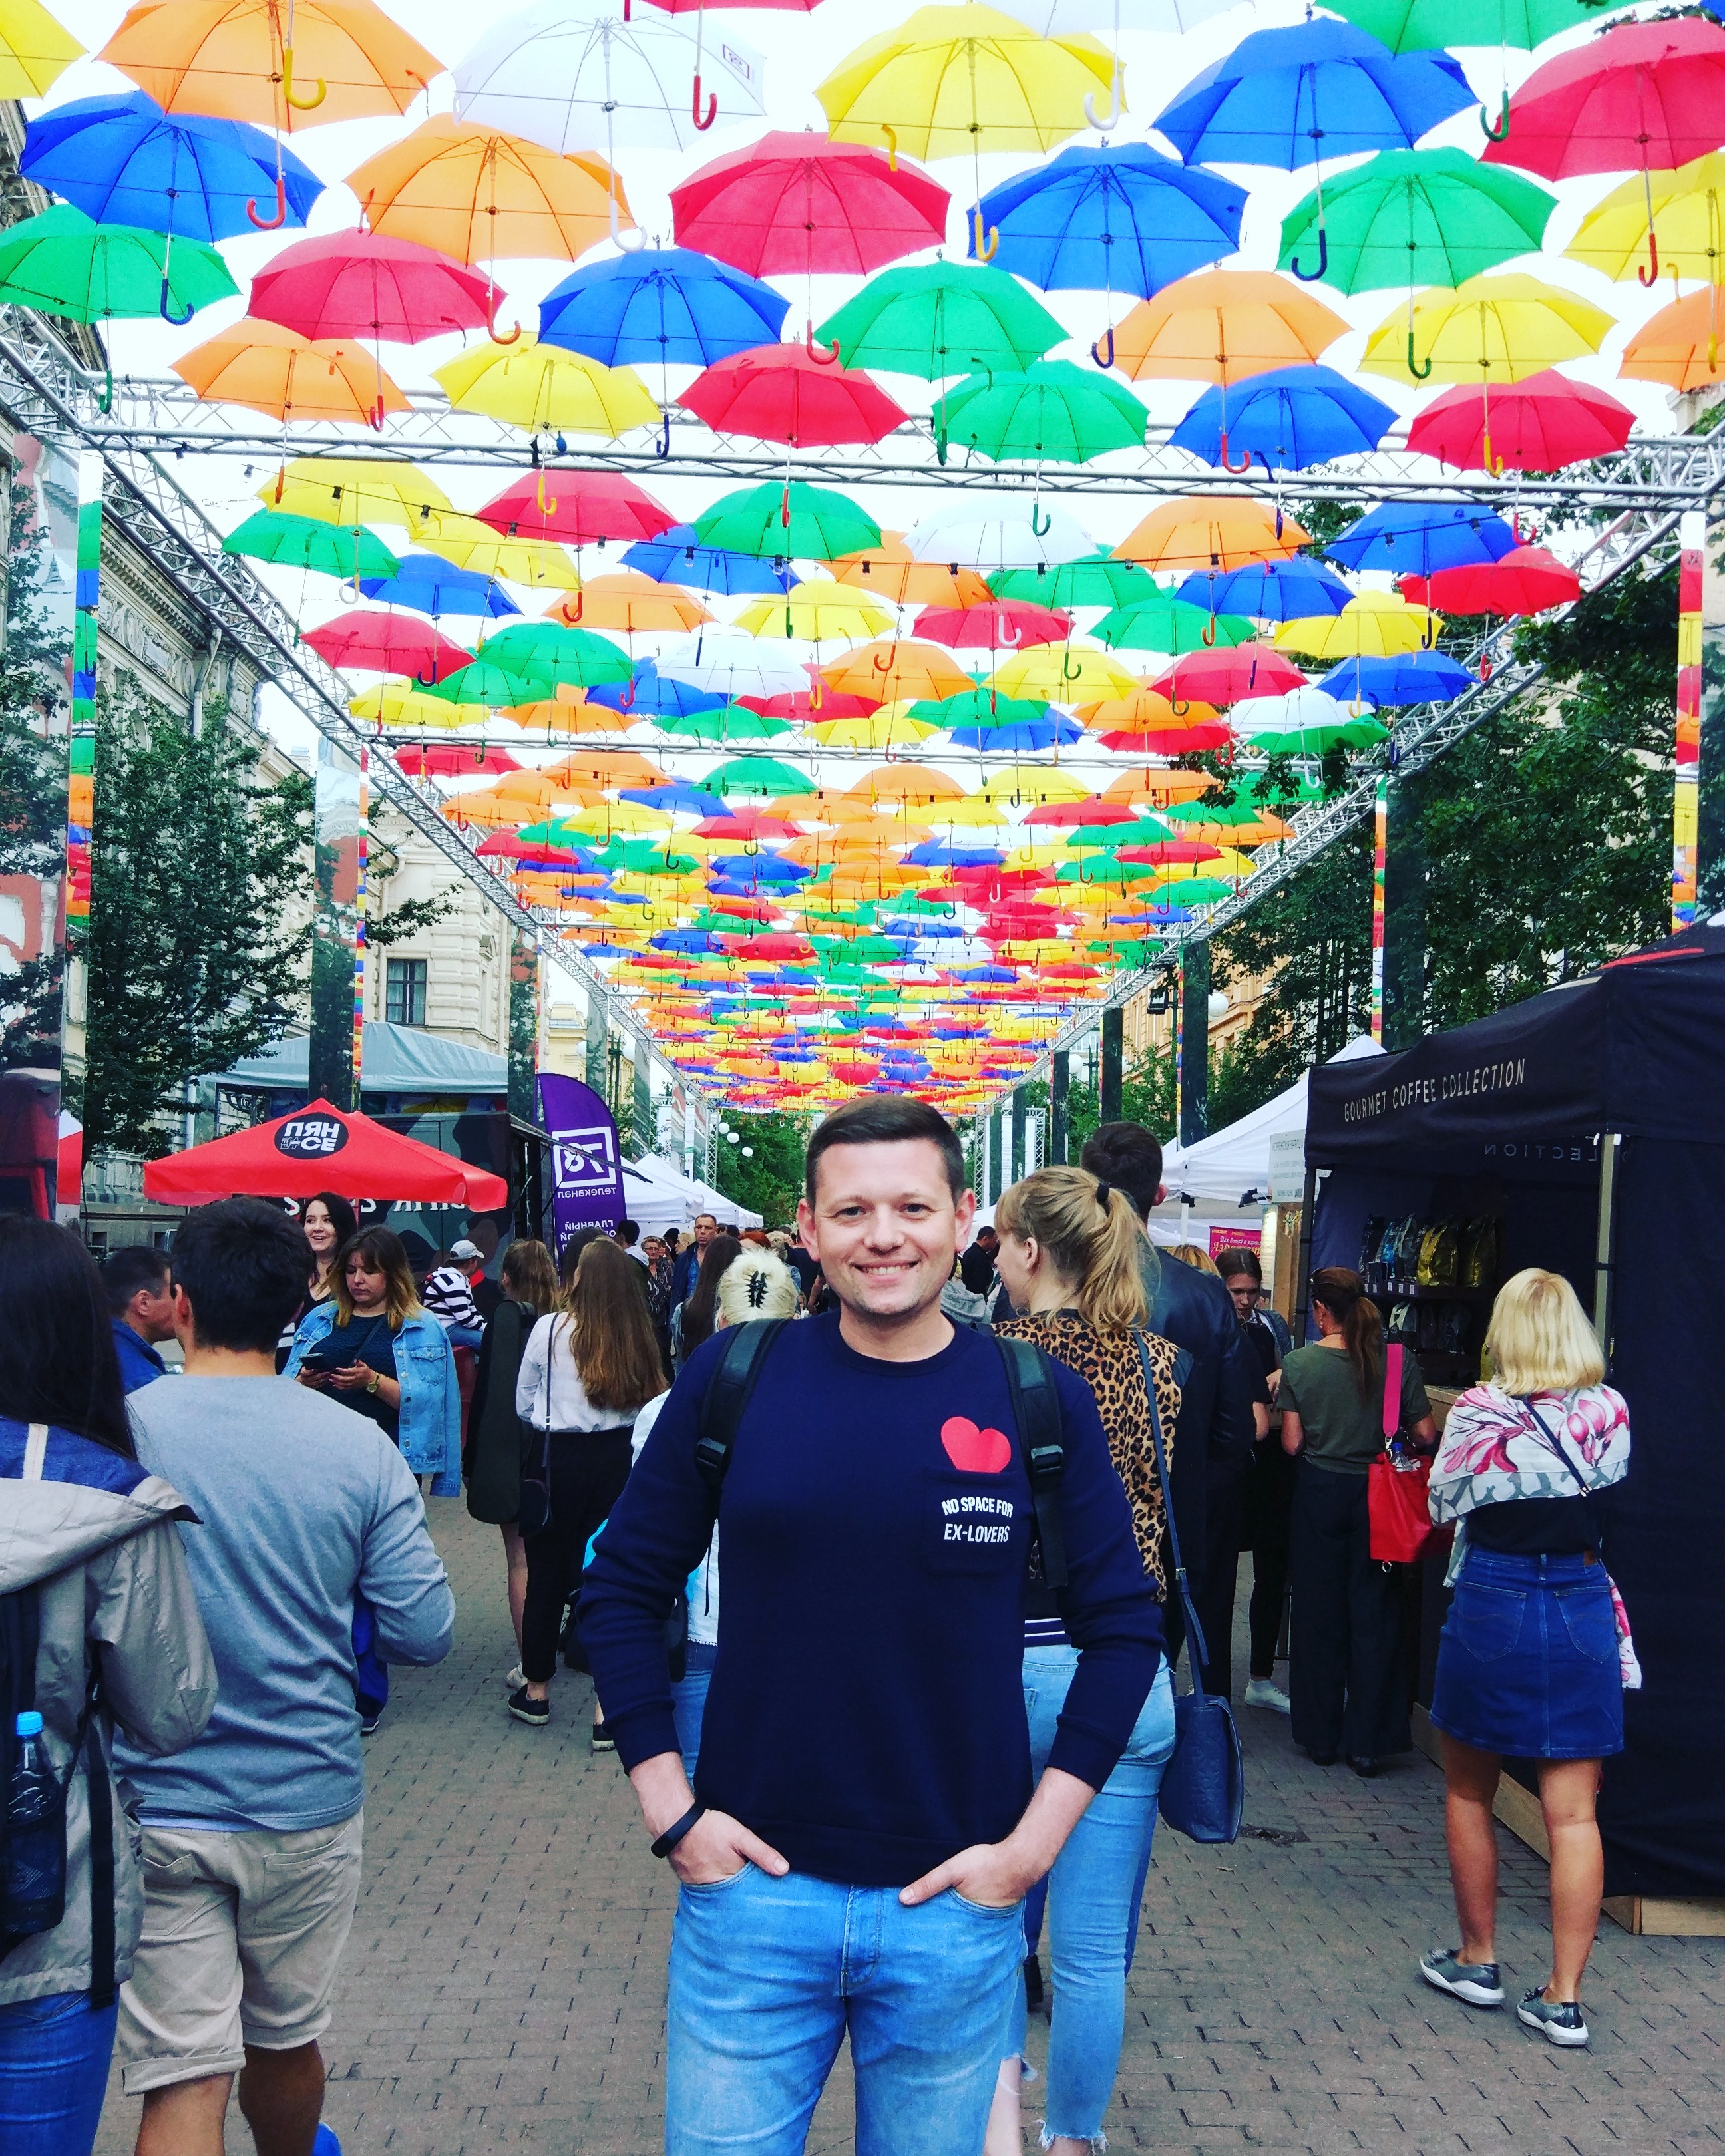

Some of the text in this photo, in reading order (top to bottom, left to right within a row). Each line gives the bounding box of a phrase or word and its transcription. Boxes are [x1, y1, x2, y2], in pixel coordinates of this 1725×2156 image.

[1344, 1058, 1525, 1122] GOURMET COFFEE COLLECTION
[284, 1121, 340, 1138] ПЯН
[941, 1497, 1014, 1518] NO SPACE FOR
[944, 1523, 1010, 1542] EX-LOVERS
